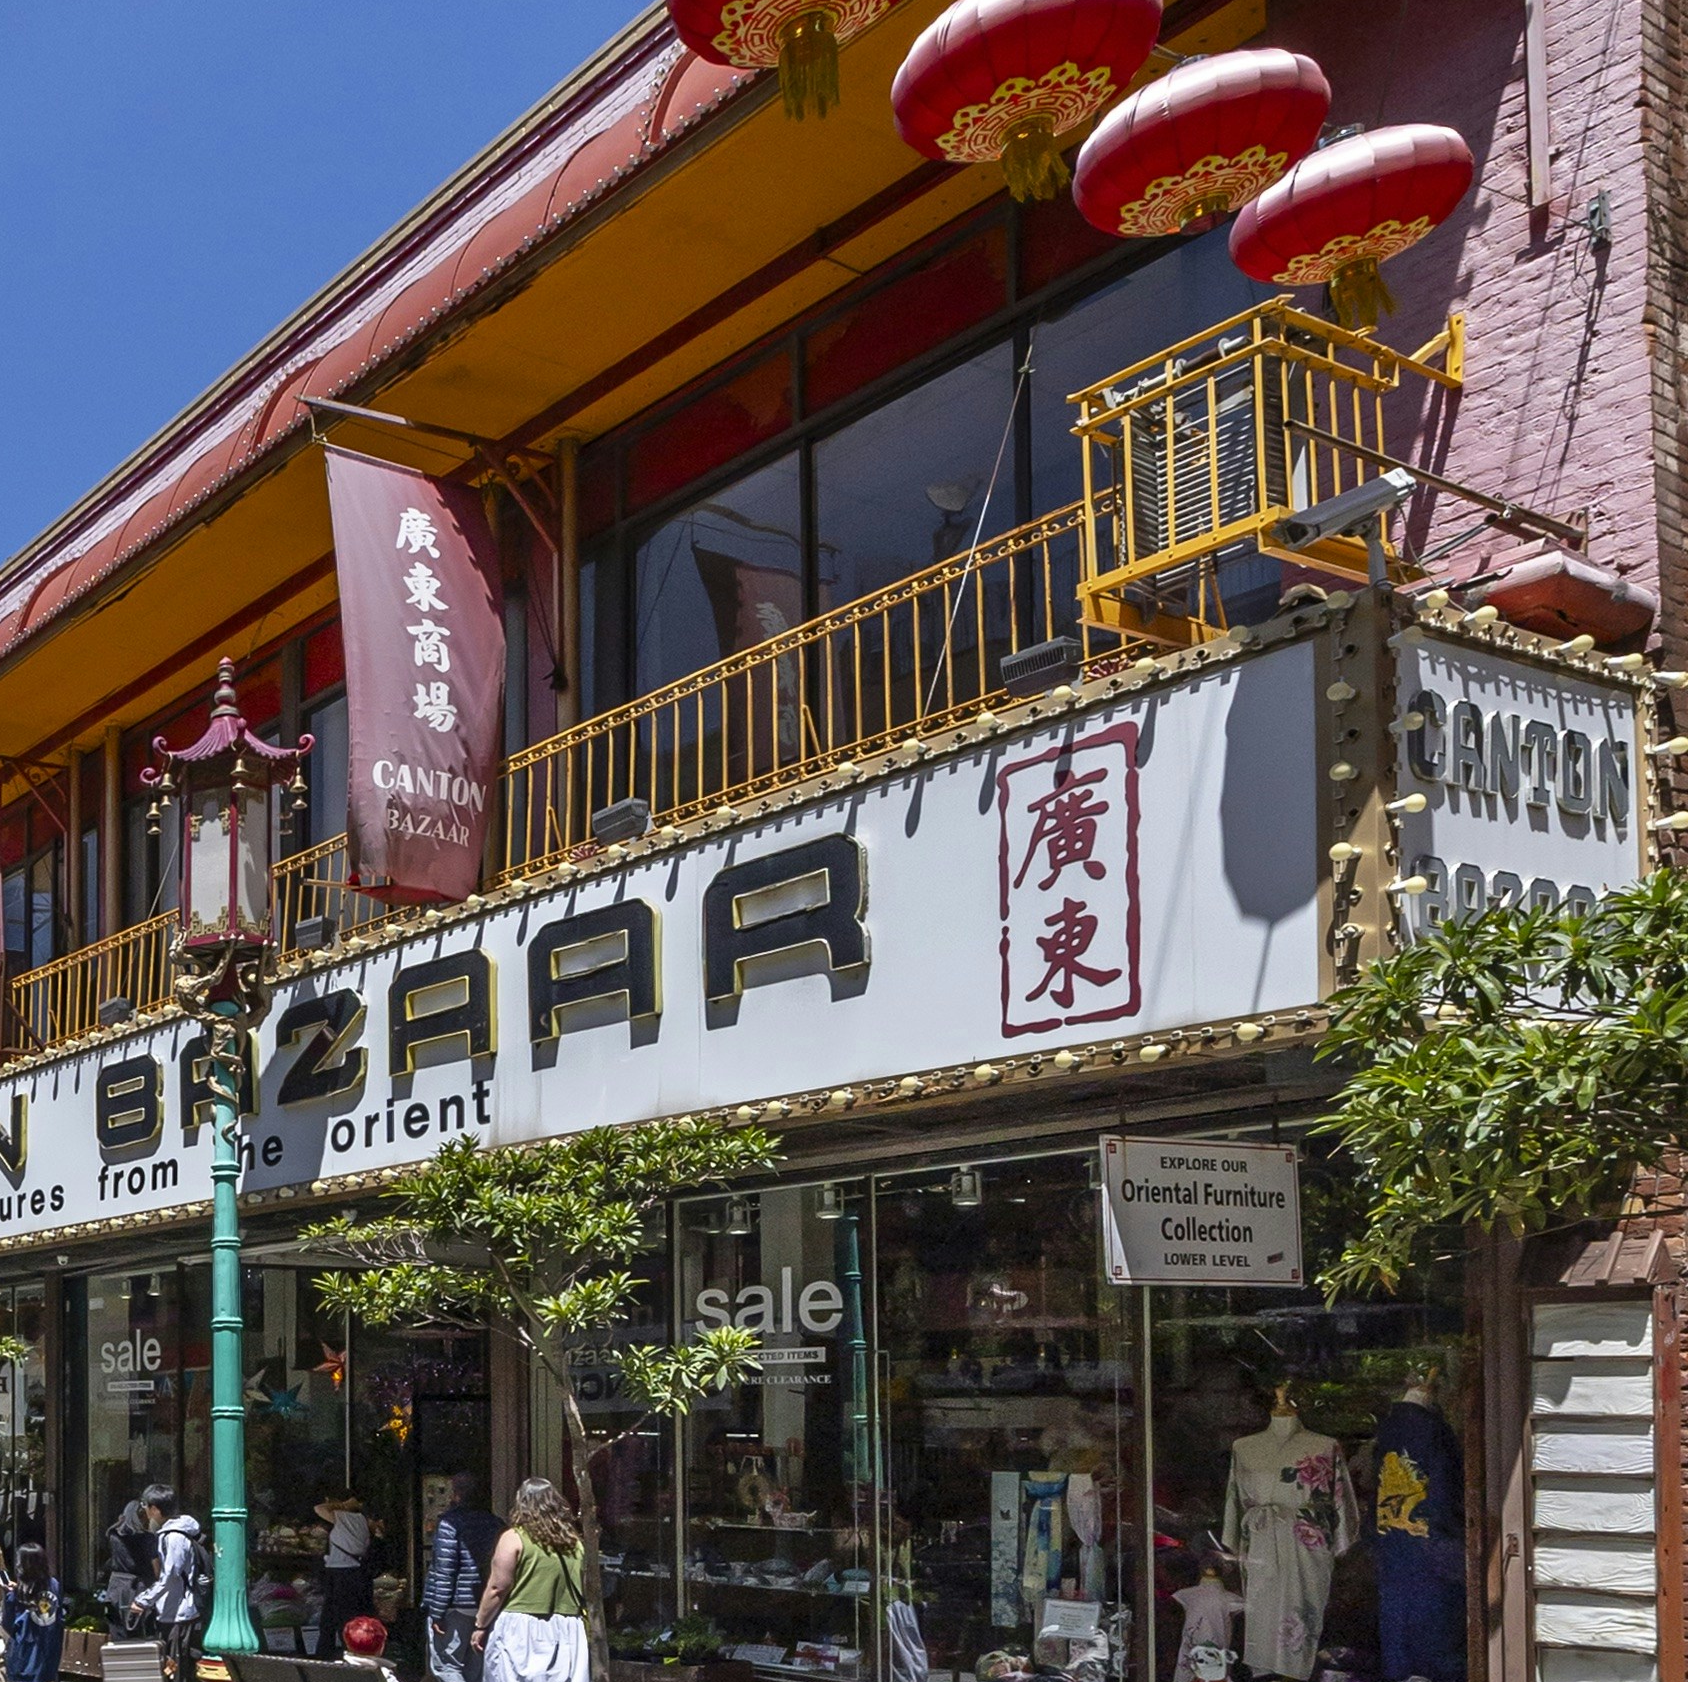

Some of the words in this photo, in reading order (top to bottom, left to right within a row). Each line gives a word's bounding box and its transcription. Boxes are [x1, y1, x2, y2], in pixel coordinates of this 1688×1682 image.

[396, 507, 458, 733] 廣東商場
[1408, 689, 1629, 821] CANTON
[372, 759, 488, 813] CANTON
[388, 809, 470, 848] BAZAAR
[1014, 768, 1123, 1009] 廣東
[96, 833, 872, 1148] BAZAAR
[98, 1159, 179, 1202] from
[237, 1132, 284, 1170] he
[330, 1079, 491, 1153] orient
[1160, 1156, 1218, 1172] EXPLORE
[1221, 1160, 1248, 1173] OUR
[1121, 1178, 1199, 1205] Oriental
[1203, 1183, 1286, 1209] Furniture
[1161, 1217, 1254, 1243] Collection
[1164, 1253, 1207, 1266] LOWER
[1212, 1255, 1251, 1267] LEVEL
[694, 1266, 844, 1337] sale
[100, 1329, 162, 1373] sale
[787, 1350, 819, 1360] ITEMS
[766, 1374, 832, 1385] CLEARANCE
